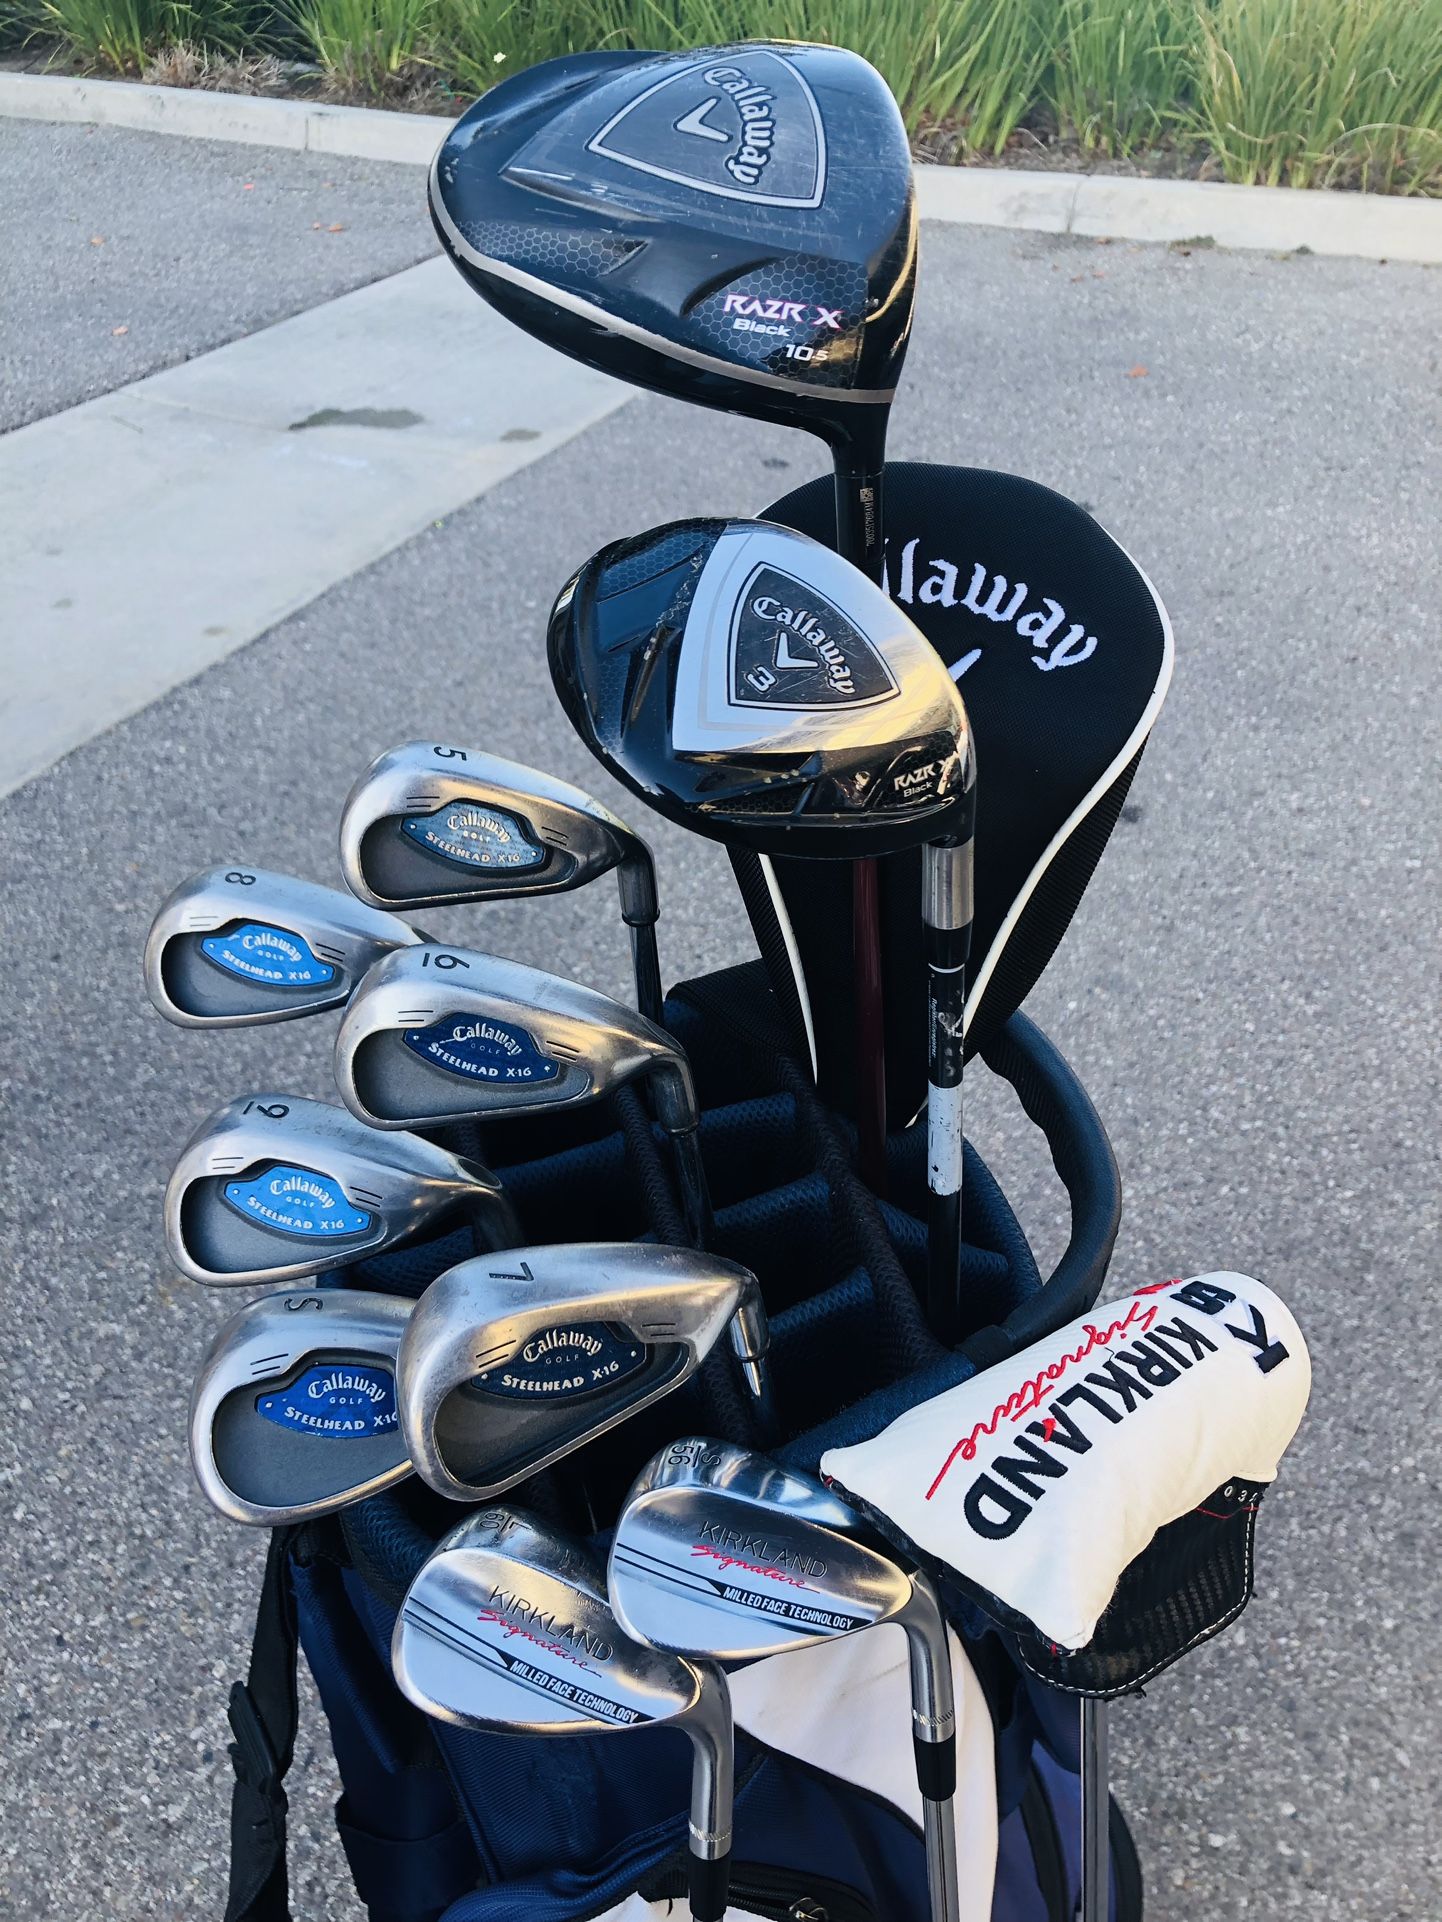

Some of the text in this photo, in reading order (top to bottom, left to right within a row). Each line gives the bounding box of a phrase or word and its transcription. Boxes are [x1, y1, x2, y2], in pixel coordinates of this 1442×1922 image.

[703, 66, 776, 184] Callaway
[723, 293, 844, 330] RAZR X
[732, 317, 792, 337] Black
[785, 343, 829, 361] 10.5
[882, 538, 1099, 672] laway
[752, 596, 856, 694] Callaway
[746, 665, 777, 692] 3
[433, 746, 467, 761] 5
[893, 762, 936, 791] RAZR
[903, 781, 933, 798] Black
[446, 811, 511, 843] Callaway
[425, 831, 491, 863] STEELHEAD
[225, 871, 257, 886] 8
[242, 932, 302, 962] Callaway
[222, 949, 283, 979] STEELHEAD
[452, 1022, 523, 1056] Callaway
[470, 1042, 501, 1055] GOLF
[428, 1042, 499, 1077] STEELHEAD
[270, 1176, 336, 1209] Callaway
[285, 1195, 316, 1208] GOLF
[247, 1196, 314, 1229] STEELHEAD
[284, 1297, 324, 1312] S
[523, 1328, 602, 1363] Callaway
[545, 1354, 580, 1365] GOLF
[308, 1372, 386, 1403] Callaway
[501, 1374, 585, 1392] STEELHEAD
[329, 1397, 363, 1405] GOLF
[925, 1301, 1158, 1500] Signature
[284, 1406, 365, 1431] STEELHEAD
[963, 1316, 1219, 1540] KIRKLAND
[699, 1520, 828, 1579] KIRKLAND
[690, 1545, 821, 1594] Signature
[488, 1585, 614, 1662] KIRKLAND
[722, 1586, 854, 1630] MILLED FACE TECHNOLOGY
[477, 1609, 603, 1678] Signature
[510, 1660, 640, 1724] MILLED FACE TECHNOLOGY
